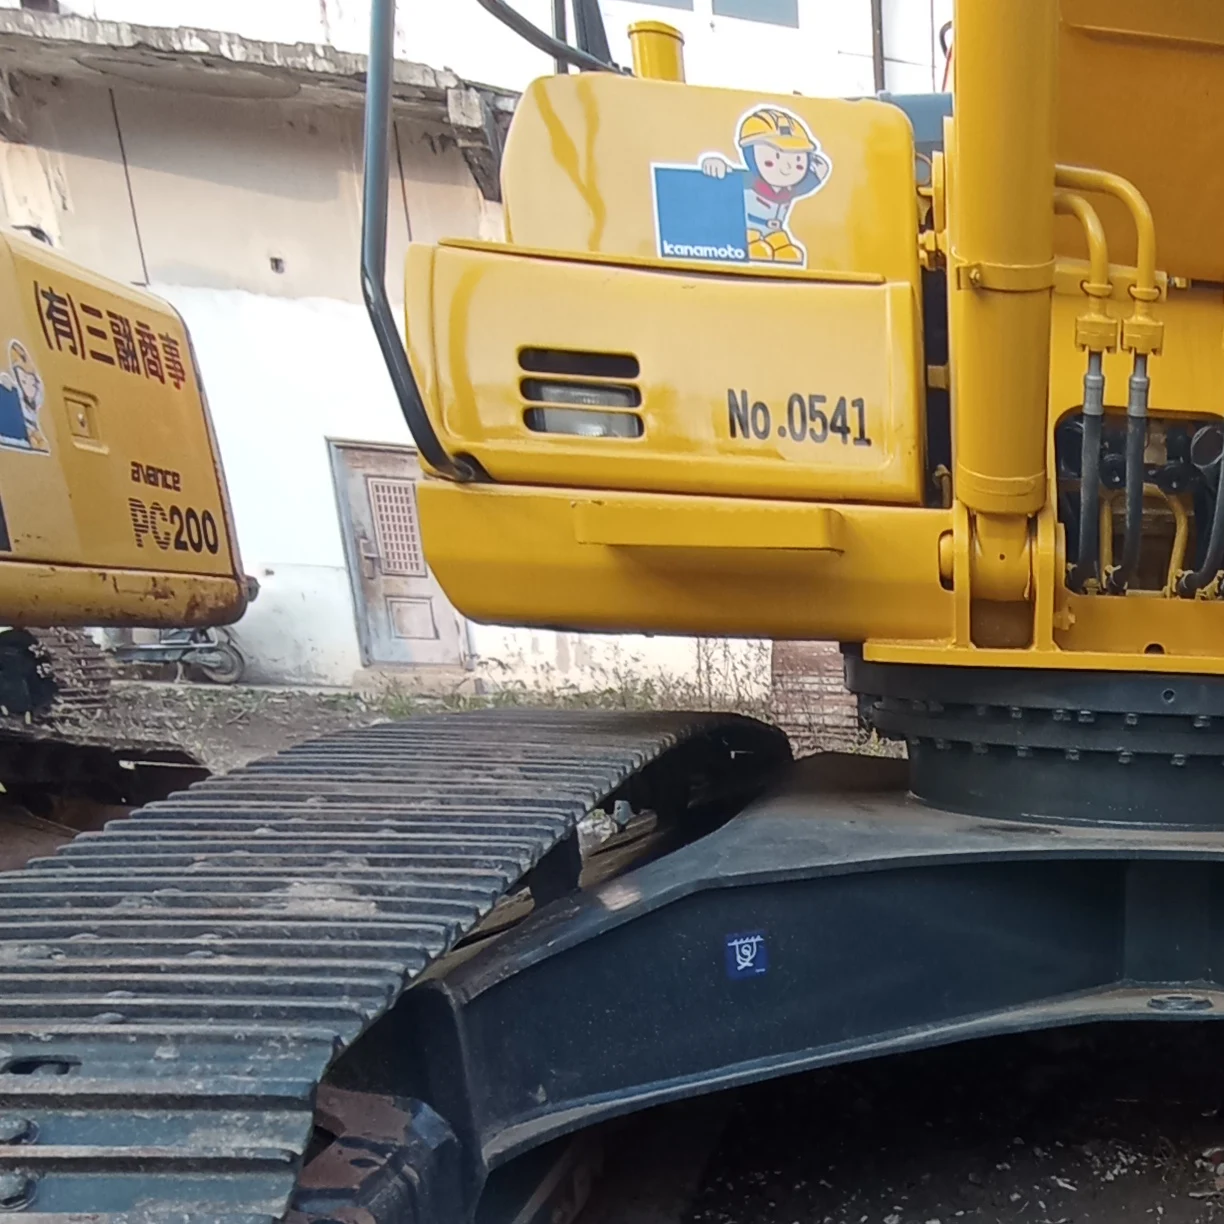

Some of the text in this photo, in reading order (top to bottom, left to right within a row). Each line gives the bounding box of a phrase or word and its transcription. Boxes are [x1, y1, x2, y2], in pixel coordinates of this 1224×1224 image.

[663, 240, 745, 260] kanamoto
[727, 388, 872, 447] No.0541
[131, 461, 181, 492] avance
[128, 497, 219, 555] PC200
